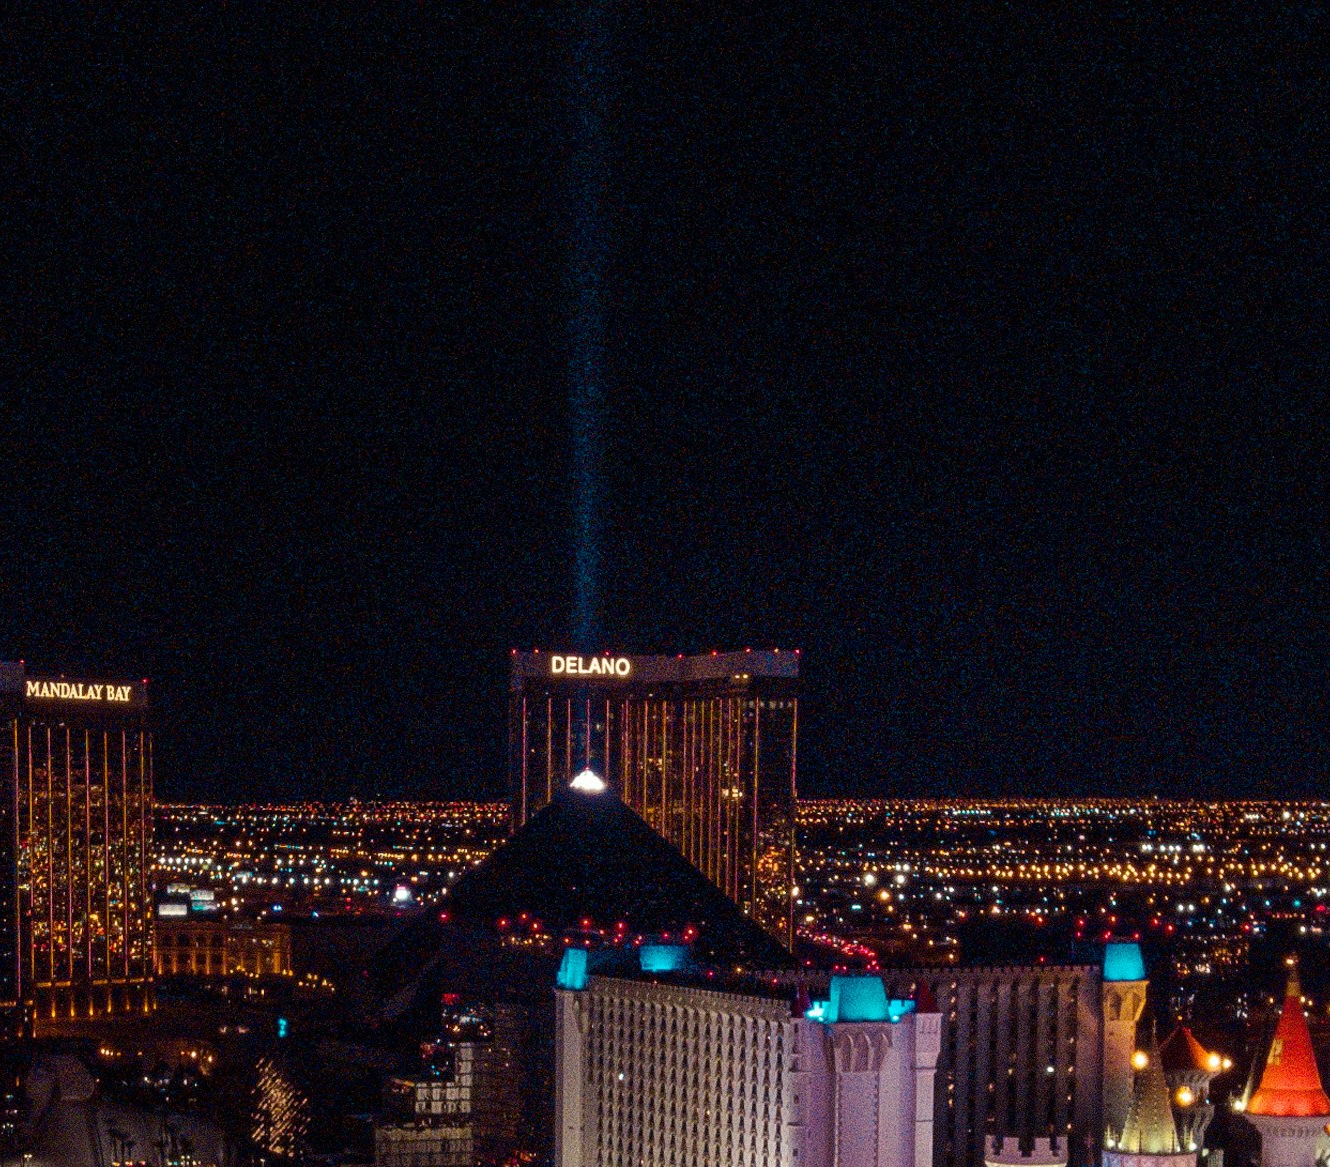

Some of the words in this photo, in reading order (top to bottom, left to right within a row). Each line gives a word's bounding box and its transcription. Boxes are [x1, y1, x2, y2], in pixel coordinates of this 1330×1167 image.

[551, 655, 630, 676] DELANO
[26, 681, 103, 700] MANDALAY
[106, 685, 131, 702] BAY
